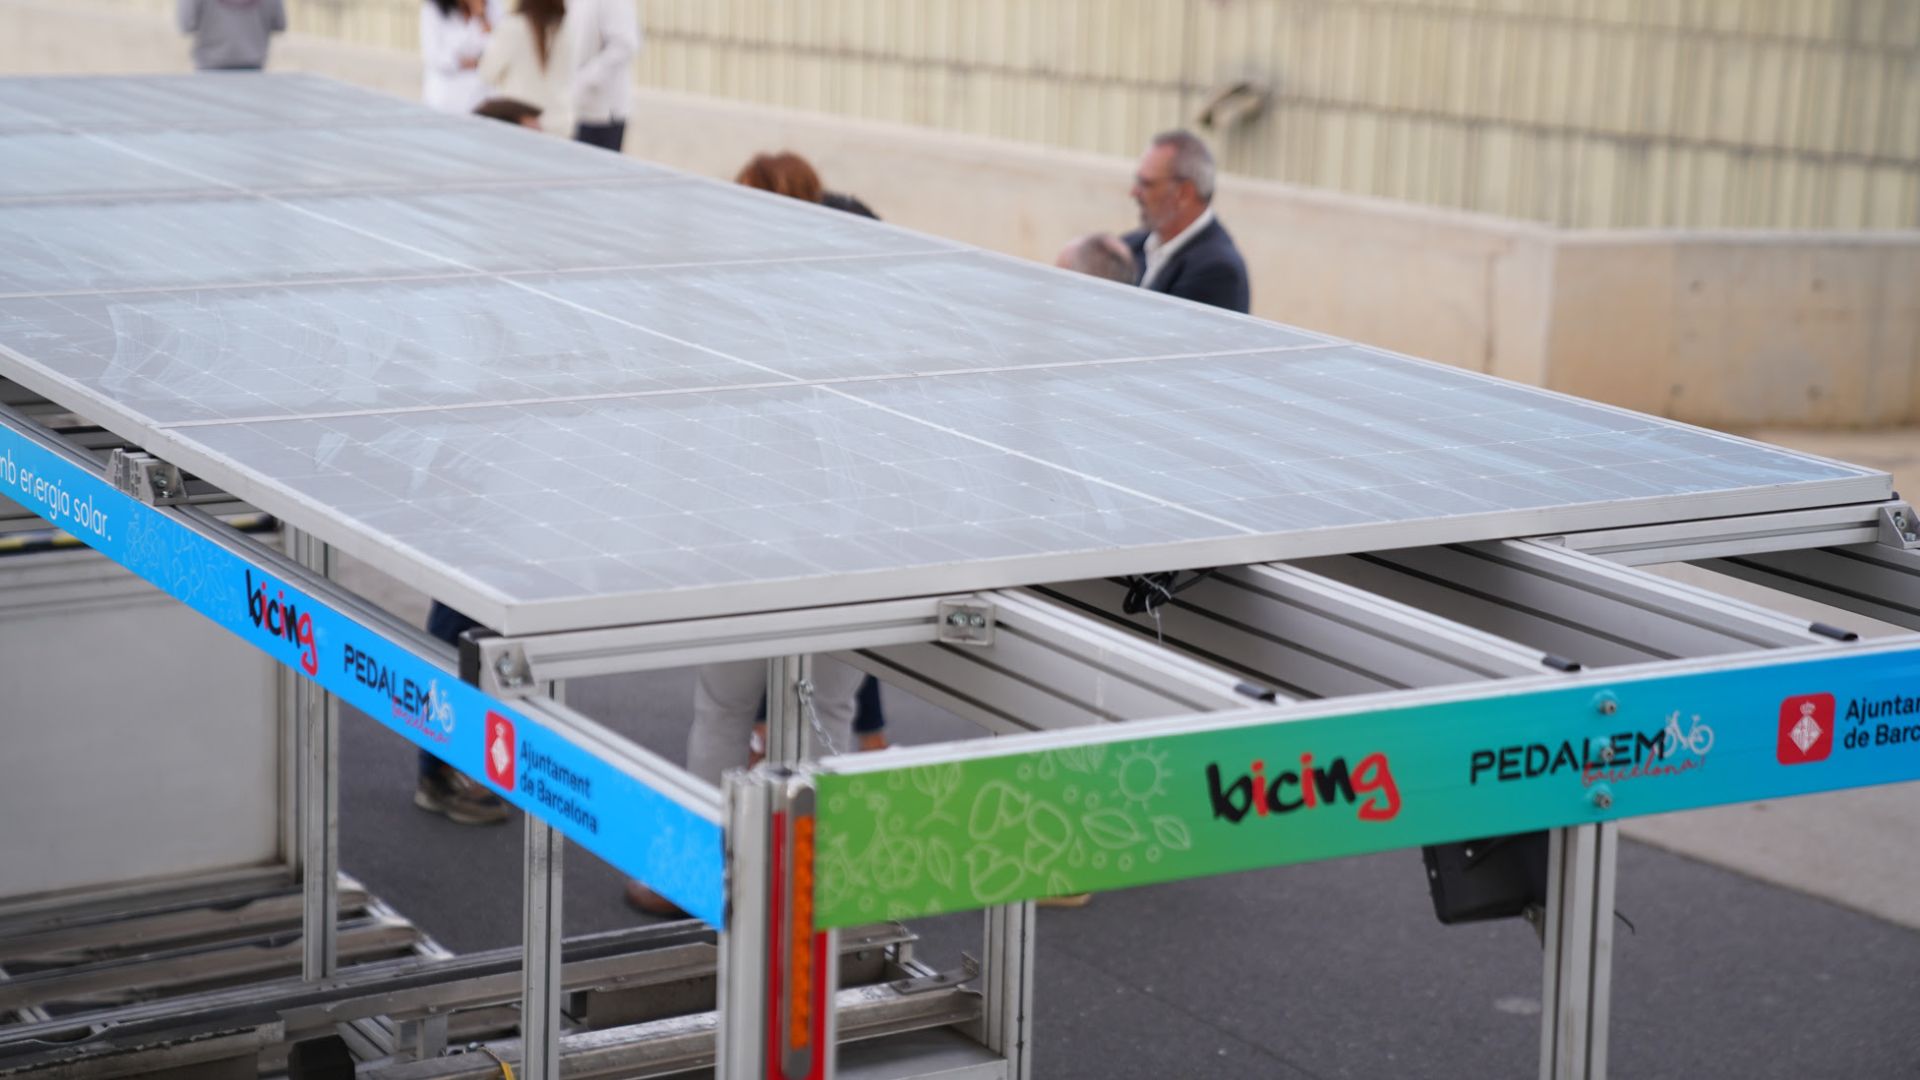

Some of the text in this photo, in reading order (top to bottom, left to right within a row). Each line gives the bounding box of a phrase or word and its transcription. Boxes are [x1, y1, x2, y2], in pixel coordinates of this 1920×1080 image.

[20, 467, 70, 520] energía
[73, 493, 113, 542] solar.
[244, 569, 318, 677] bicing
[344, 643, 431, 722] PEDALEM
[1844, 694, 1920, 726] Ajunta
[519, 739, 591, 800] Ajuntament
[1470, 728, 1667, 785] PEDALEM
[1843, 725, 1870, 749] de
[519, 771, 598, 836] de Barcelona
[1206, 752, 1402, 825] bicing
